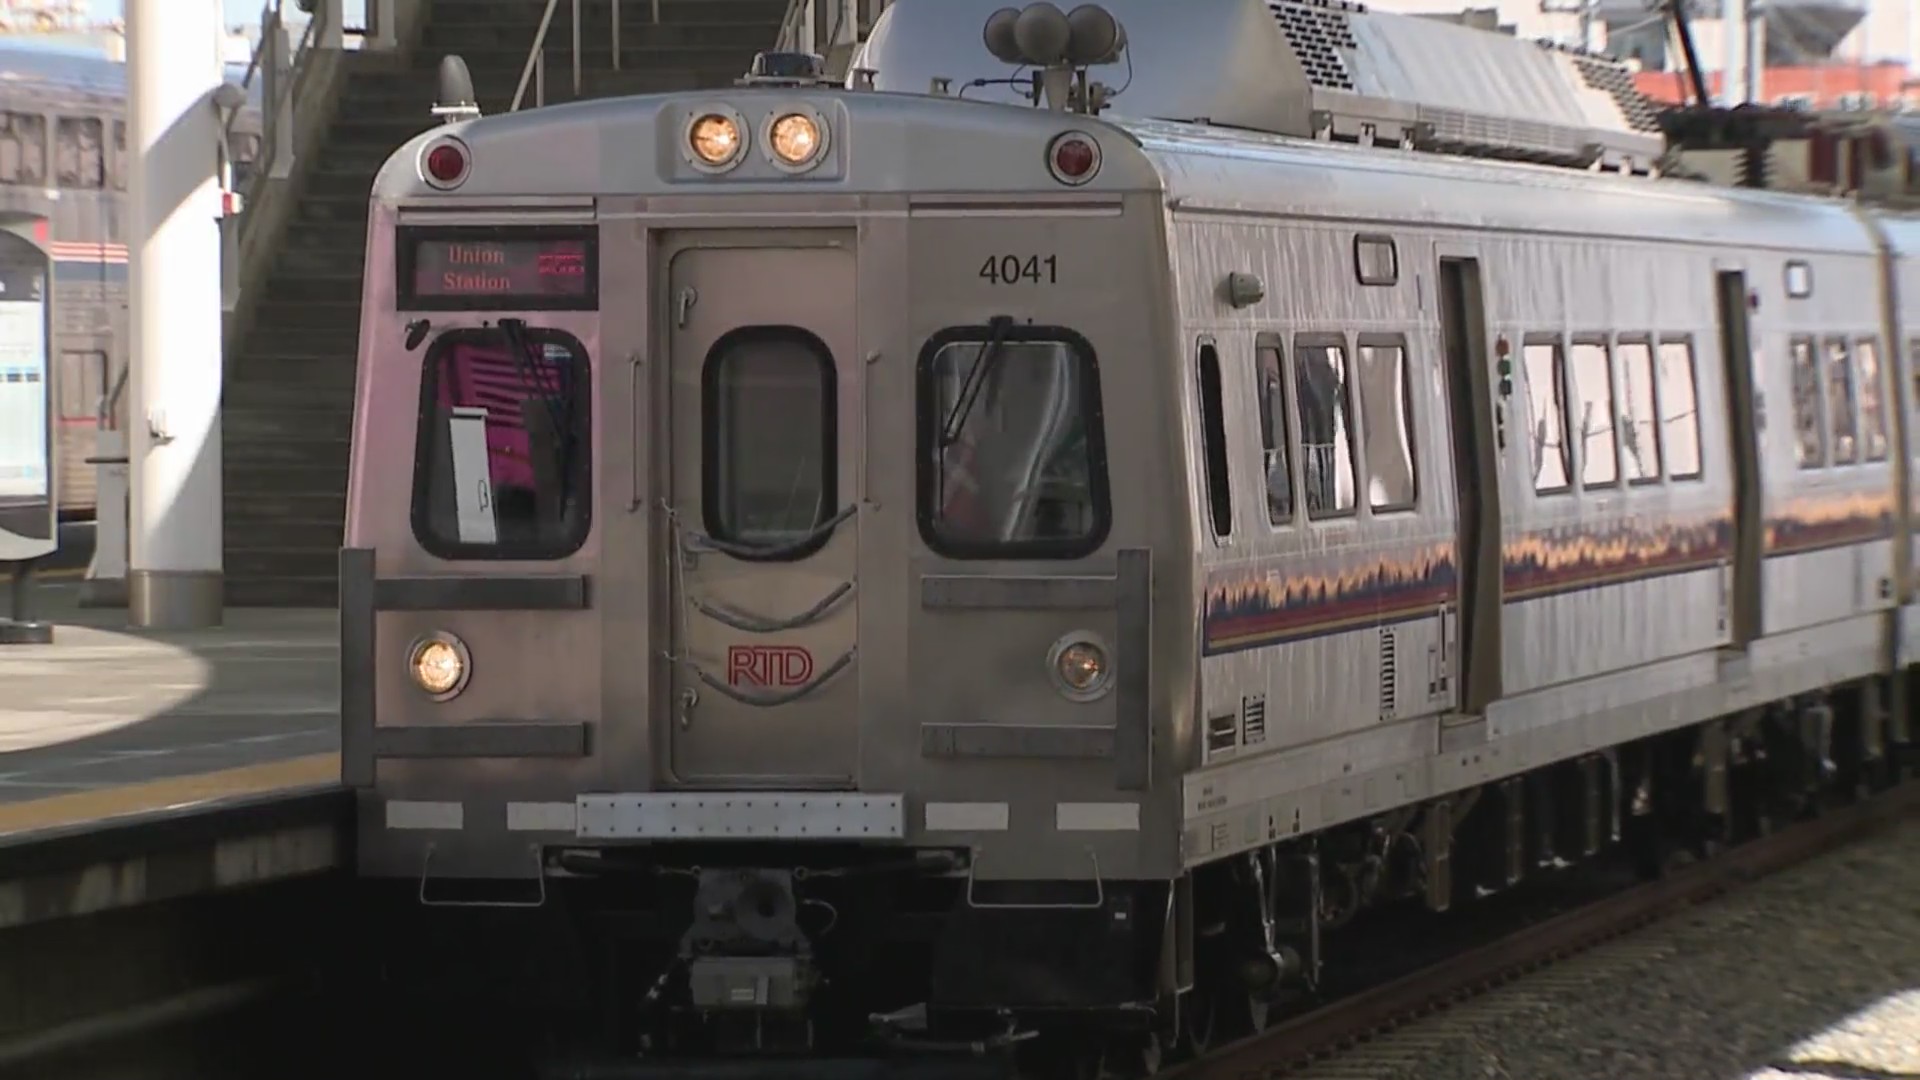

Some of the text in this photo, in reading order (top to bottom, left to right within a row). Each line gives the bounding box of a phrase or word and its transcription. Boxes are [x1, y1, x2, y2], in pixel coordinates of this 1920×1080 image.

[448, 245, 505, 264] Union
[443, 271, 511, 290] Station
[979, 254, 1057, 285] 4041
[728, 645, 814, 686] RTD
